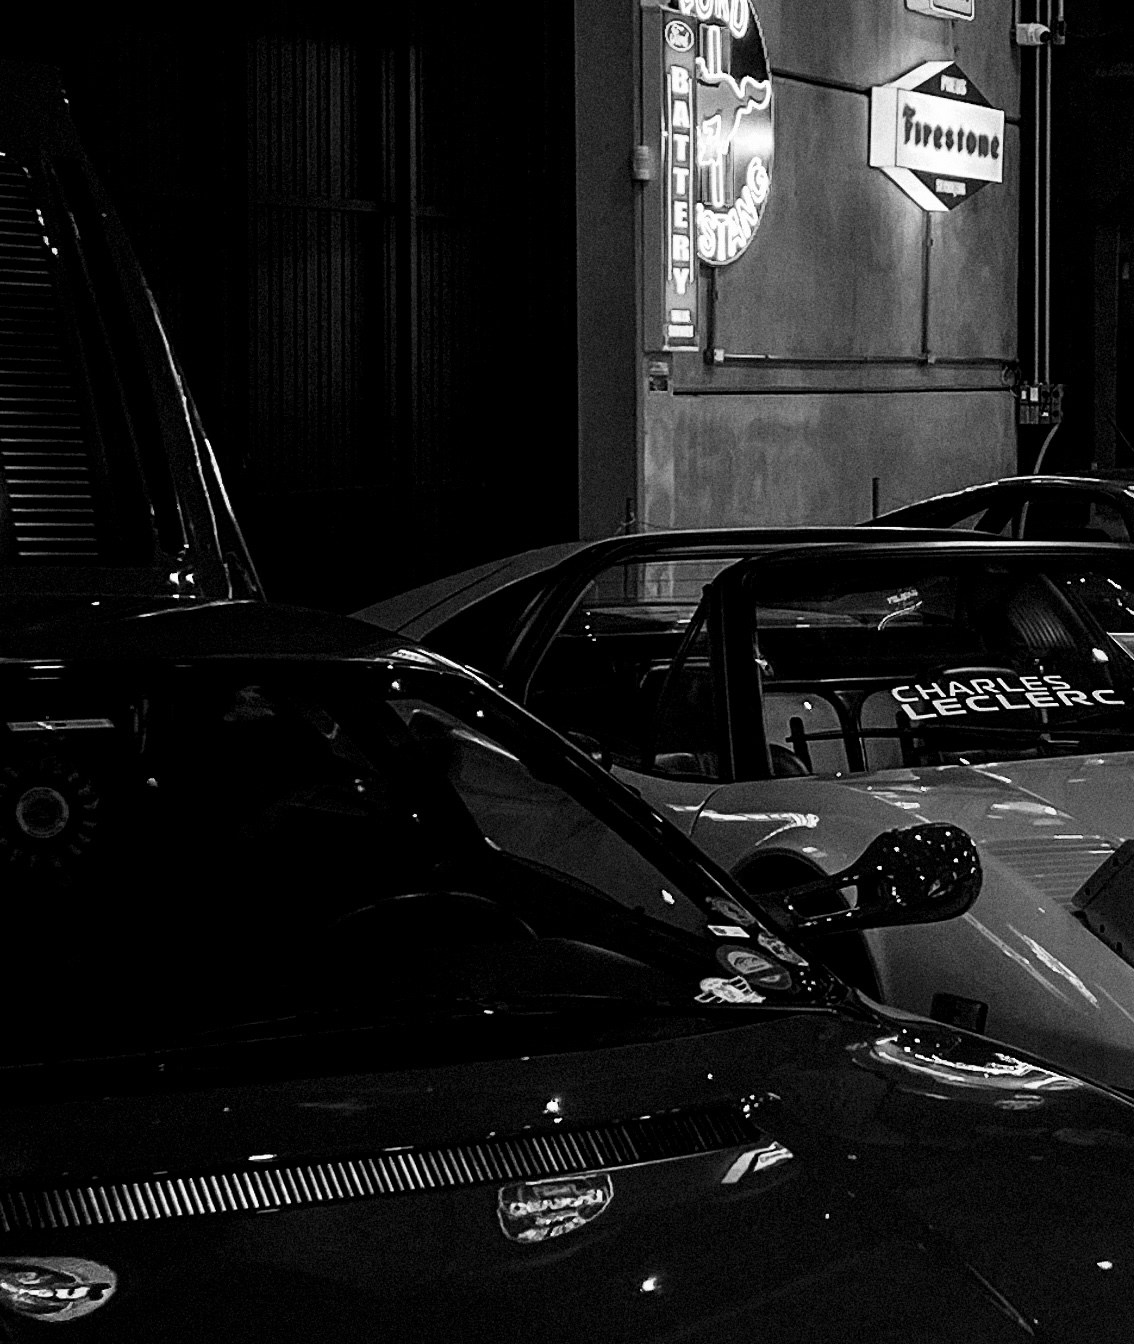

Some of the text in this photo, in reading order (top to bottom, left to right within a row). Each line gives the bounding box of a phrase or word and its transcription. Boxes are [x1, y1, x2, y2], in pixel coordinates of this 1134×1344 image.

[902, 103, 1001, 161] Firestone
[670, 65, 691, 295] BATTERY
[891, 675, 1071, 703] CHARLES
[901, 689, 1126, 721] LECLERC
